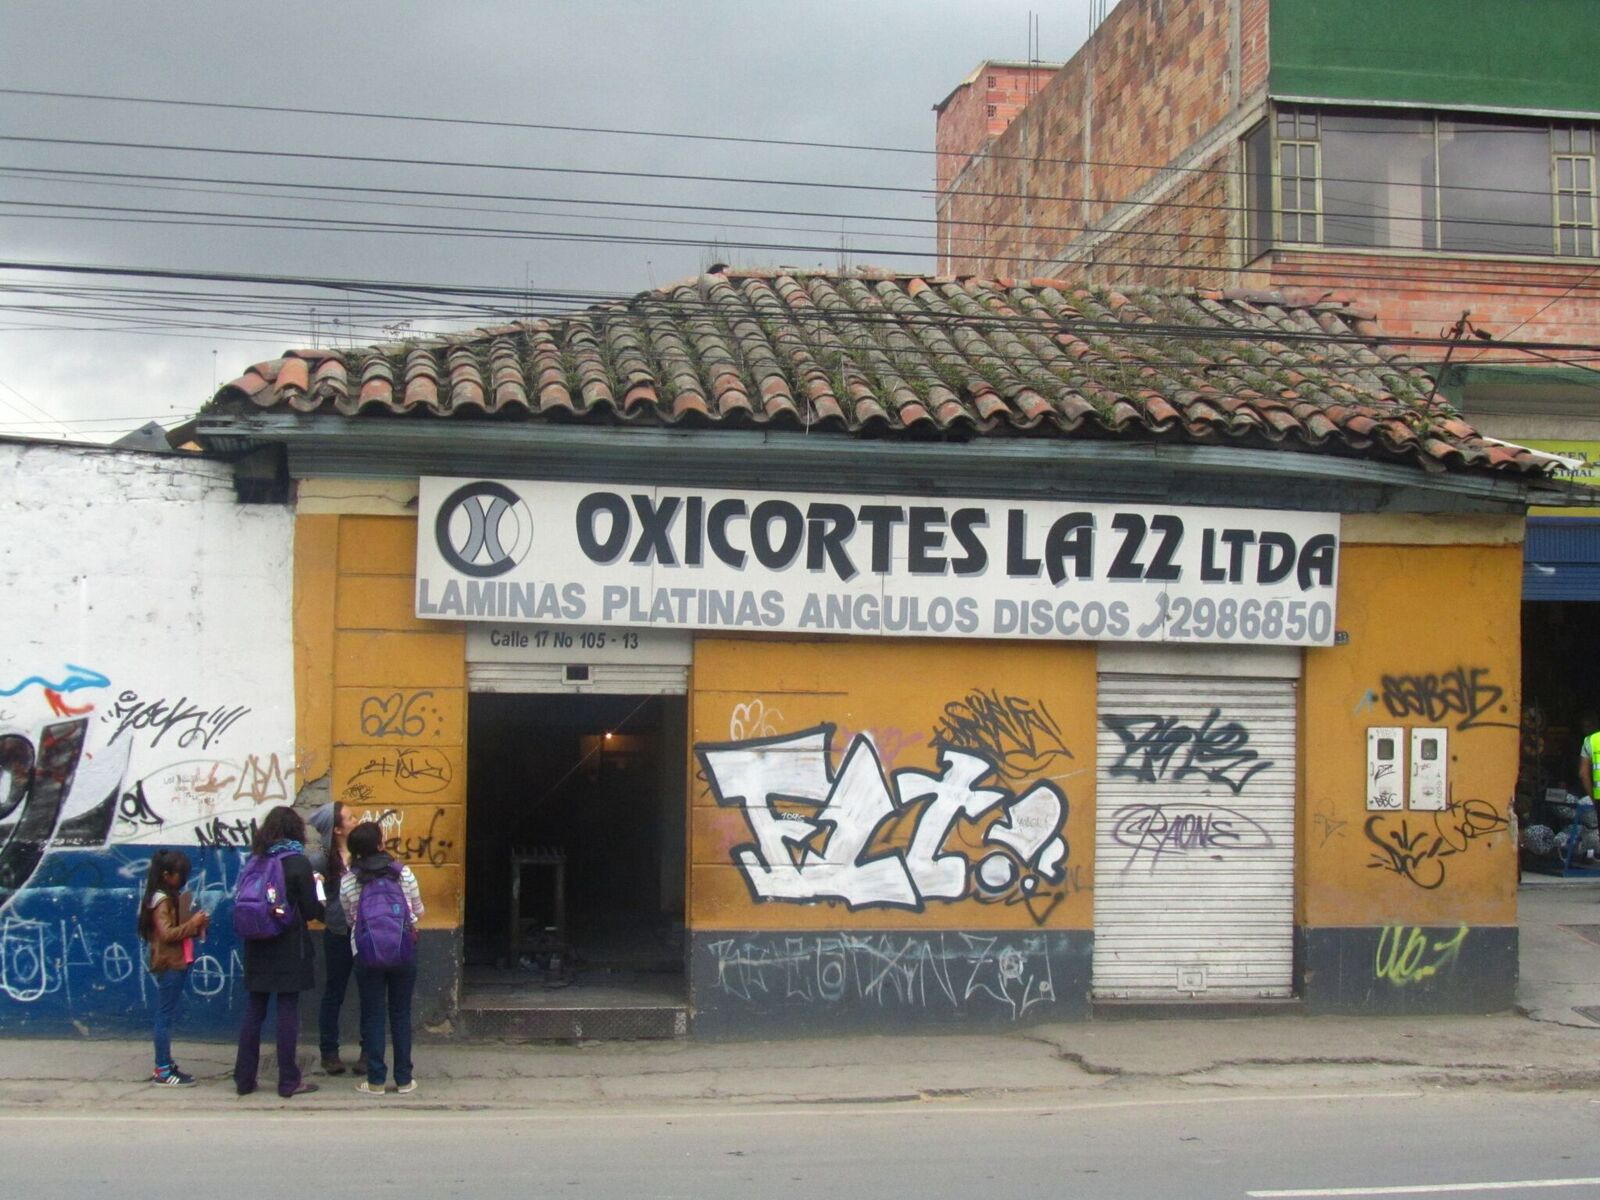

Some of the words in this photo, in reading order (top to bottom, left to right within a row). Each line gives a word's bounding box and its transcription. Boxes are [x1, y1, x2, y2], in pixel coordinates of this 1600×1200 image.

[576, 492, 989, 583] OXICORTES
[1006, 508, 1097, 587] LA
[1106, 512, 1186, 581] 22
[1200, 528, 1337, 592] LTDA
[418, 578, 586, 620] LAMINAS
[602, 585, 786, 627] PLATINAS
[798, 592, 979, 634] ANGULOS
[993, 599, 1131, 637] DISCOS
[1168, 597, 1332, 643] 2986850
[490, 629, 529, 648] Calle
[534, 630, 549, 648] 17
[553, 631, 573, 649] No
[580, 631, 607, 649] 105
[622, 632, 639, 649] 13
